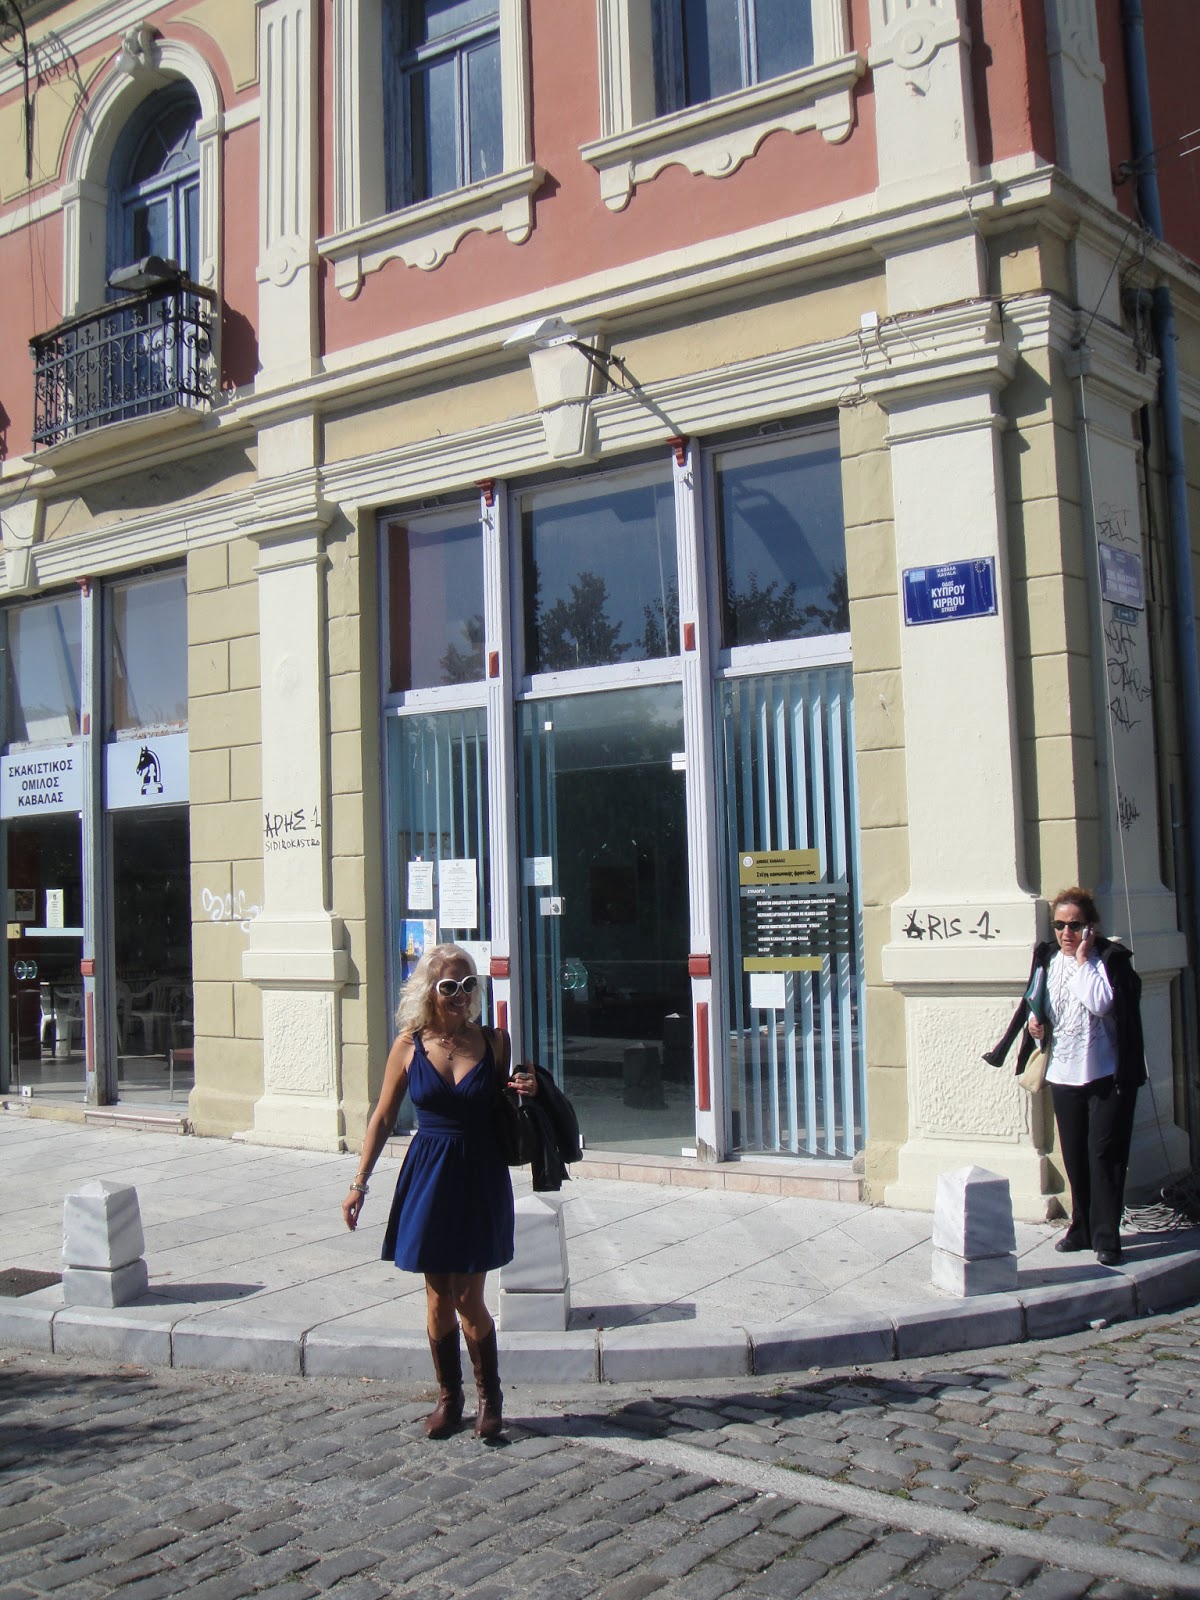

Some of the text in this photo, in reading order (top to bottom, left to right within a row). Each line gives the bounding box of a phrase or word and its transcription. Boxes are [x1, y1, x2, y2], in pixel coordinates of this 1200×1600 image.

[931, 584, 966, 598] ΚΥΠΡΟΥ
[933, 596, 965, 609] KIPROU
[8, 759, 73, 778] ΣΚΑΚΙΣΤΙΚΟΣ
[21, 776, 60, 791] ΟΜΙΛΟΣ
[18, 791, 64, 807] ΚΑΒΑΛΑΣ
